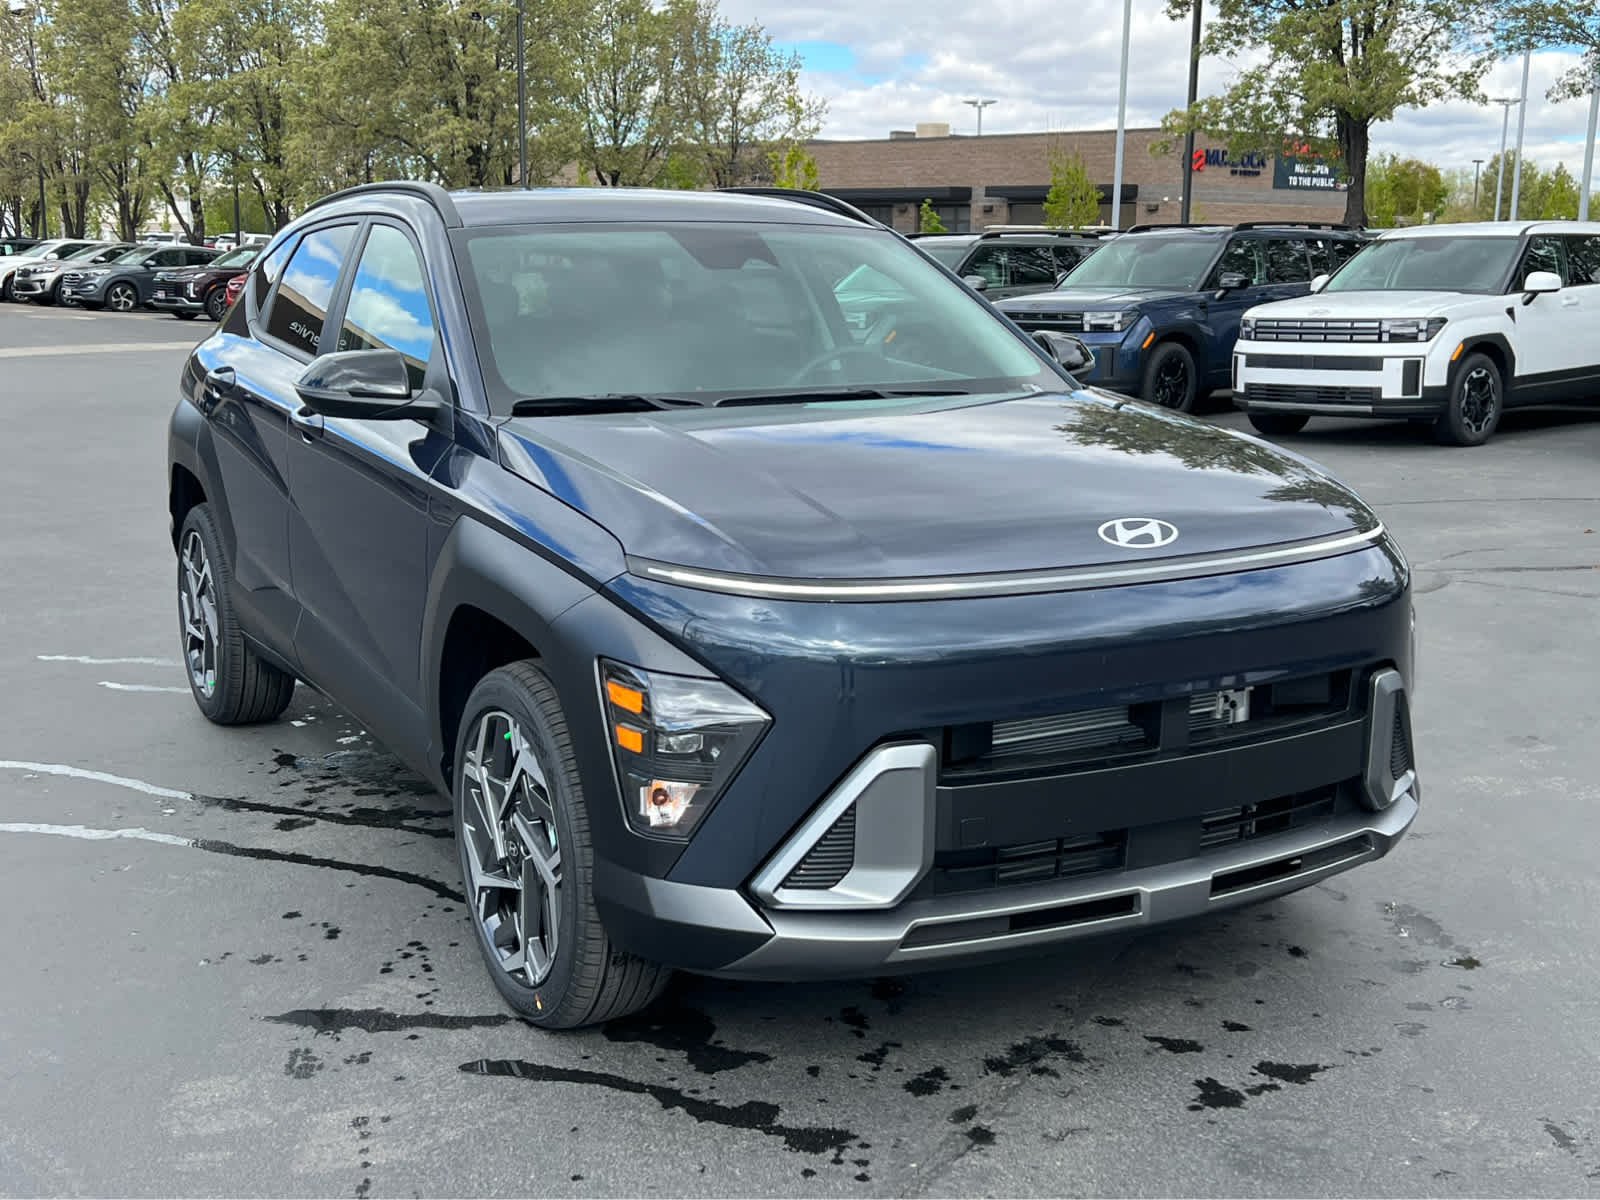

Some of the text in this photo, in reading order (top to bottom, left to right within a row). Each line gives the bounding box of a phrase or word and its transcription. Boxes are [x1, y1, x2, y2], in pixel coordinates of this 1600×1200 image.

[1288, 175, 1335, 187] TO THE PUBLIC
